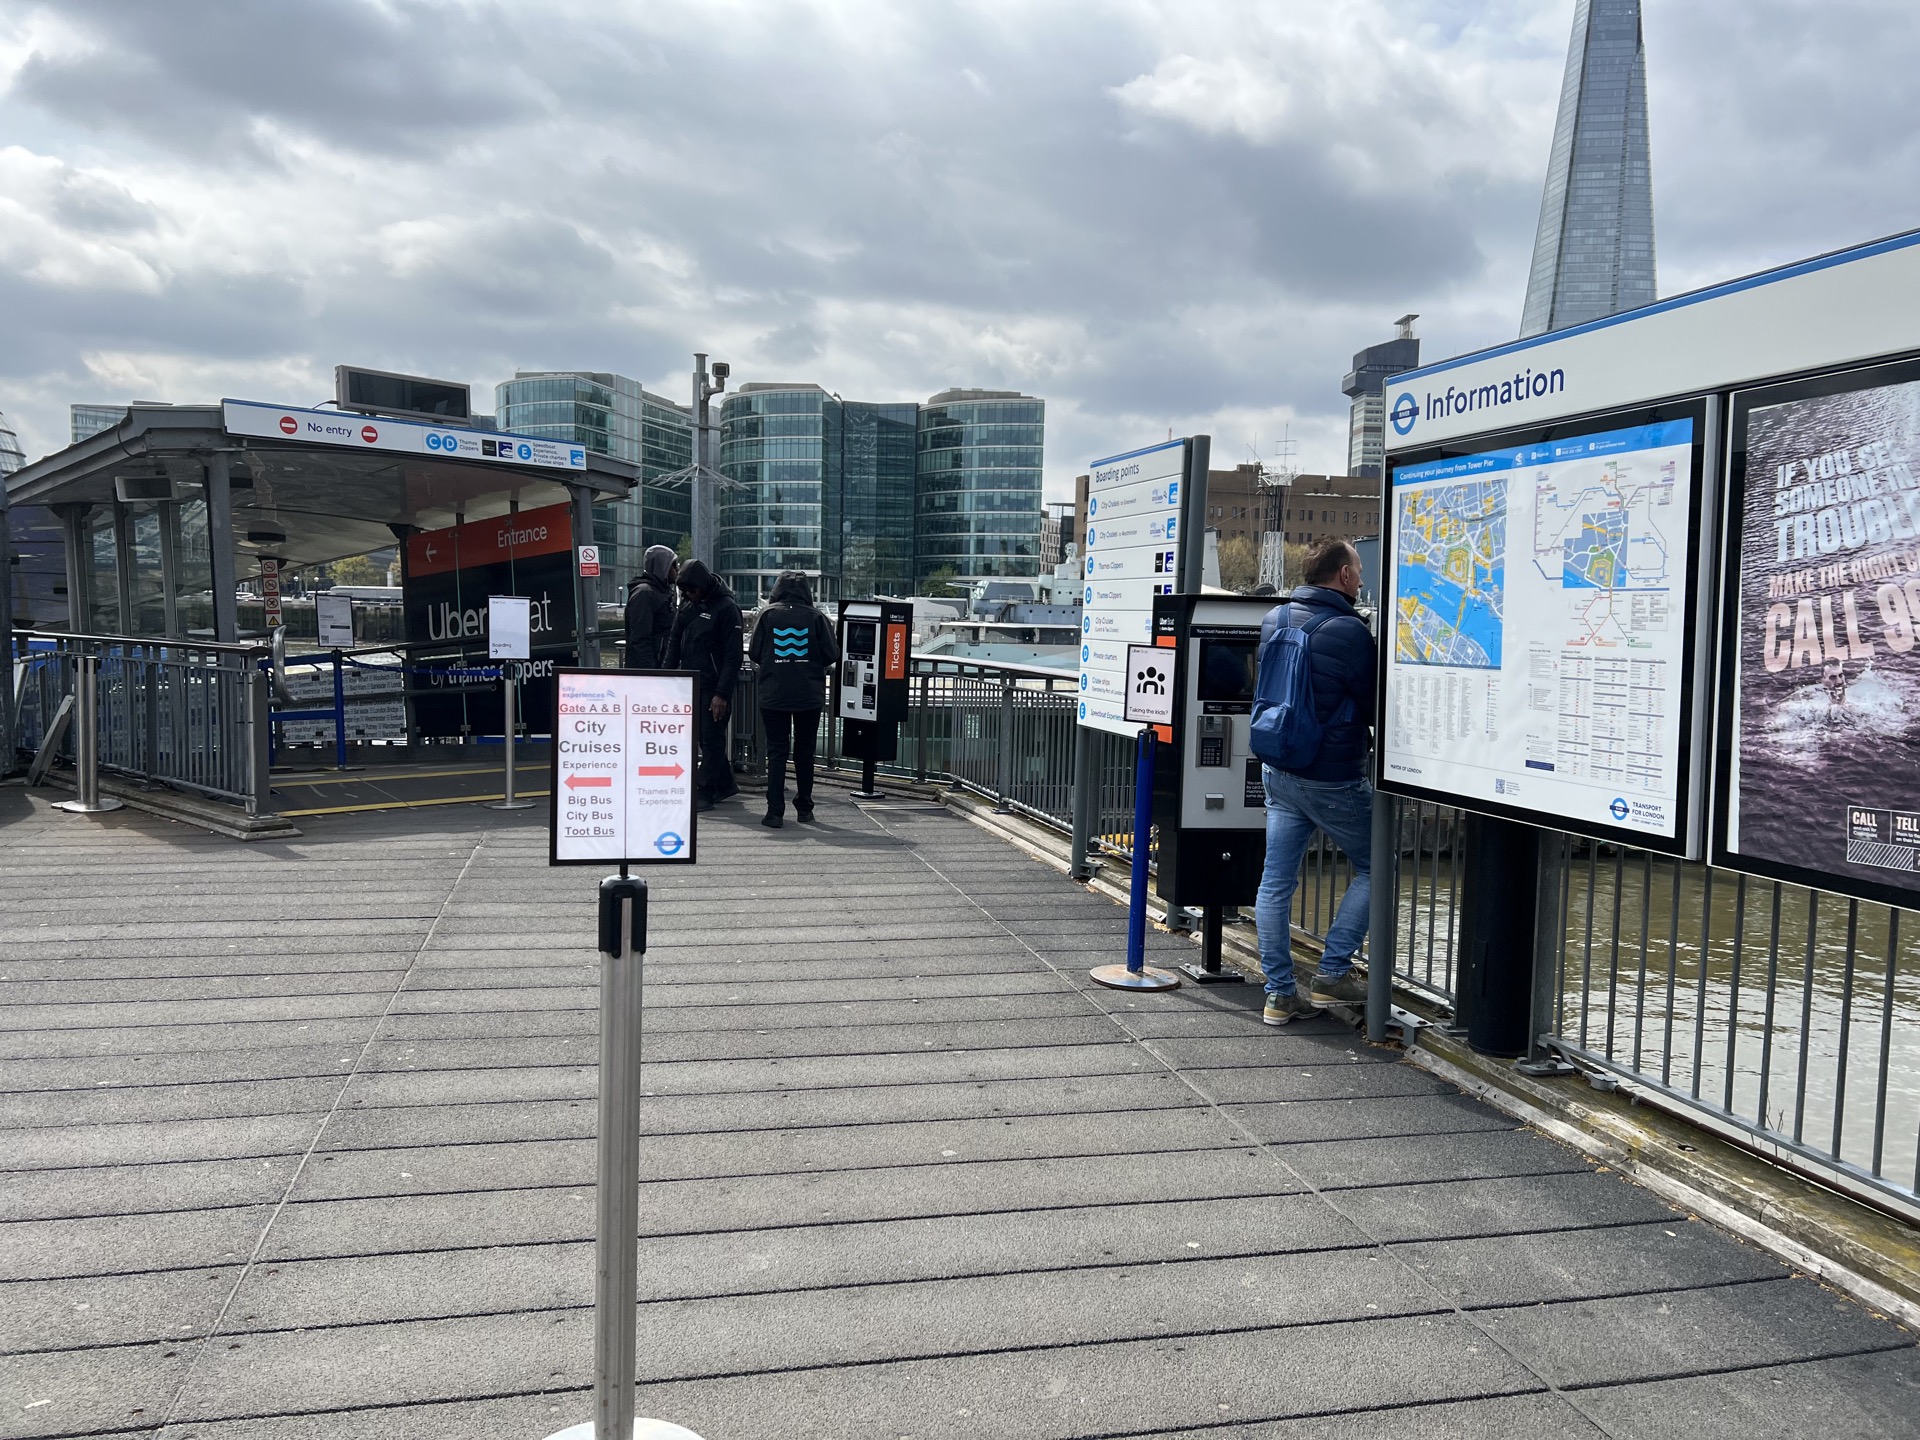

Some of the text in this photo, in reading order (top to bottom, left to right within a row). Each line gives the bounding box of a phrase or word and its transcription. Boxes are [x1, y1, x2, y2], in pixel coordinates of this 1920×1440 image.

[1426, 368, 1565, 420] Information
[307, 422, 352, 438] No entry
[429, 436, 455, 448] C D
[532, 442, 556, 450] Speedboat
[521, 447, 529, 457] E
[1095, 463, 1140, 483] Boarding points
[1399, 459, 1494, 480] Continuing your journey from Tower Pier
[1777, 460, 1796, 488] IF
[1802, 450, 1851, 482] YOU
[1775, 463, 1917, 516] SOMEONE IN
[1108, 500, 1119, 508] Cruises
[497, 525, 547, 548] Entrance
[1098, 561, 1124, 570] Thames Clippers
[1769, 569, 1814, 597] MAKE
[1818, 561, 1850, 588] THE
[1852, 554, 1901, 583] RIGHT
[1096, 591, 1122, 600] Thames Clippers
[428, 601, 488, 641] Uber
[1159, 617, 1167, 626] Uber
[1763, 591, 1876, 673] CALL
[891, 632, 900, 671] Tickets
[1093, 651, 1117, 661] Private charters
[1092, 676, 1110, 686] Cruise ships
[559, 703, 621, 713] Gate A & B
[632, 703, 692, 714] Gate C & D
[1090, 708, 1106, 718] Speedboat
[1129, 706, 1145, 714] Taking
[575, 720, 606, 736] City
[640, 720, 684, 734] River
[559, 740, 621, 753] Cruises
[645, 741, 678, 755] Bus
[562, 761, 618, 770] Experience
[637, 787, 669, 795] Thames
[568, 795, 612, 806] Big Bus
[639, 797, 682, 806] Experience
[1632, 801, 1662, 812] TRANSPORT
[566, 811, 613, 822] City Bus
[1642, 810, 1665, 820] LONDON
[1852, 811, 1878, 827] CALL
[1895, 816, 1920, 832] TELL
[565, 826, 615, 836] Toot Bus
